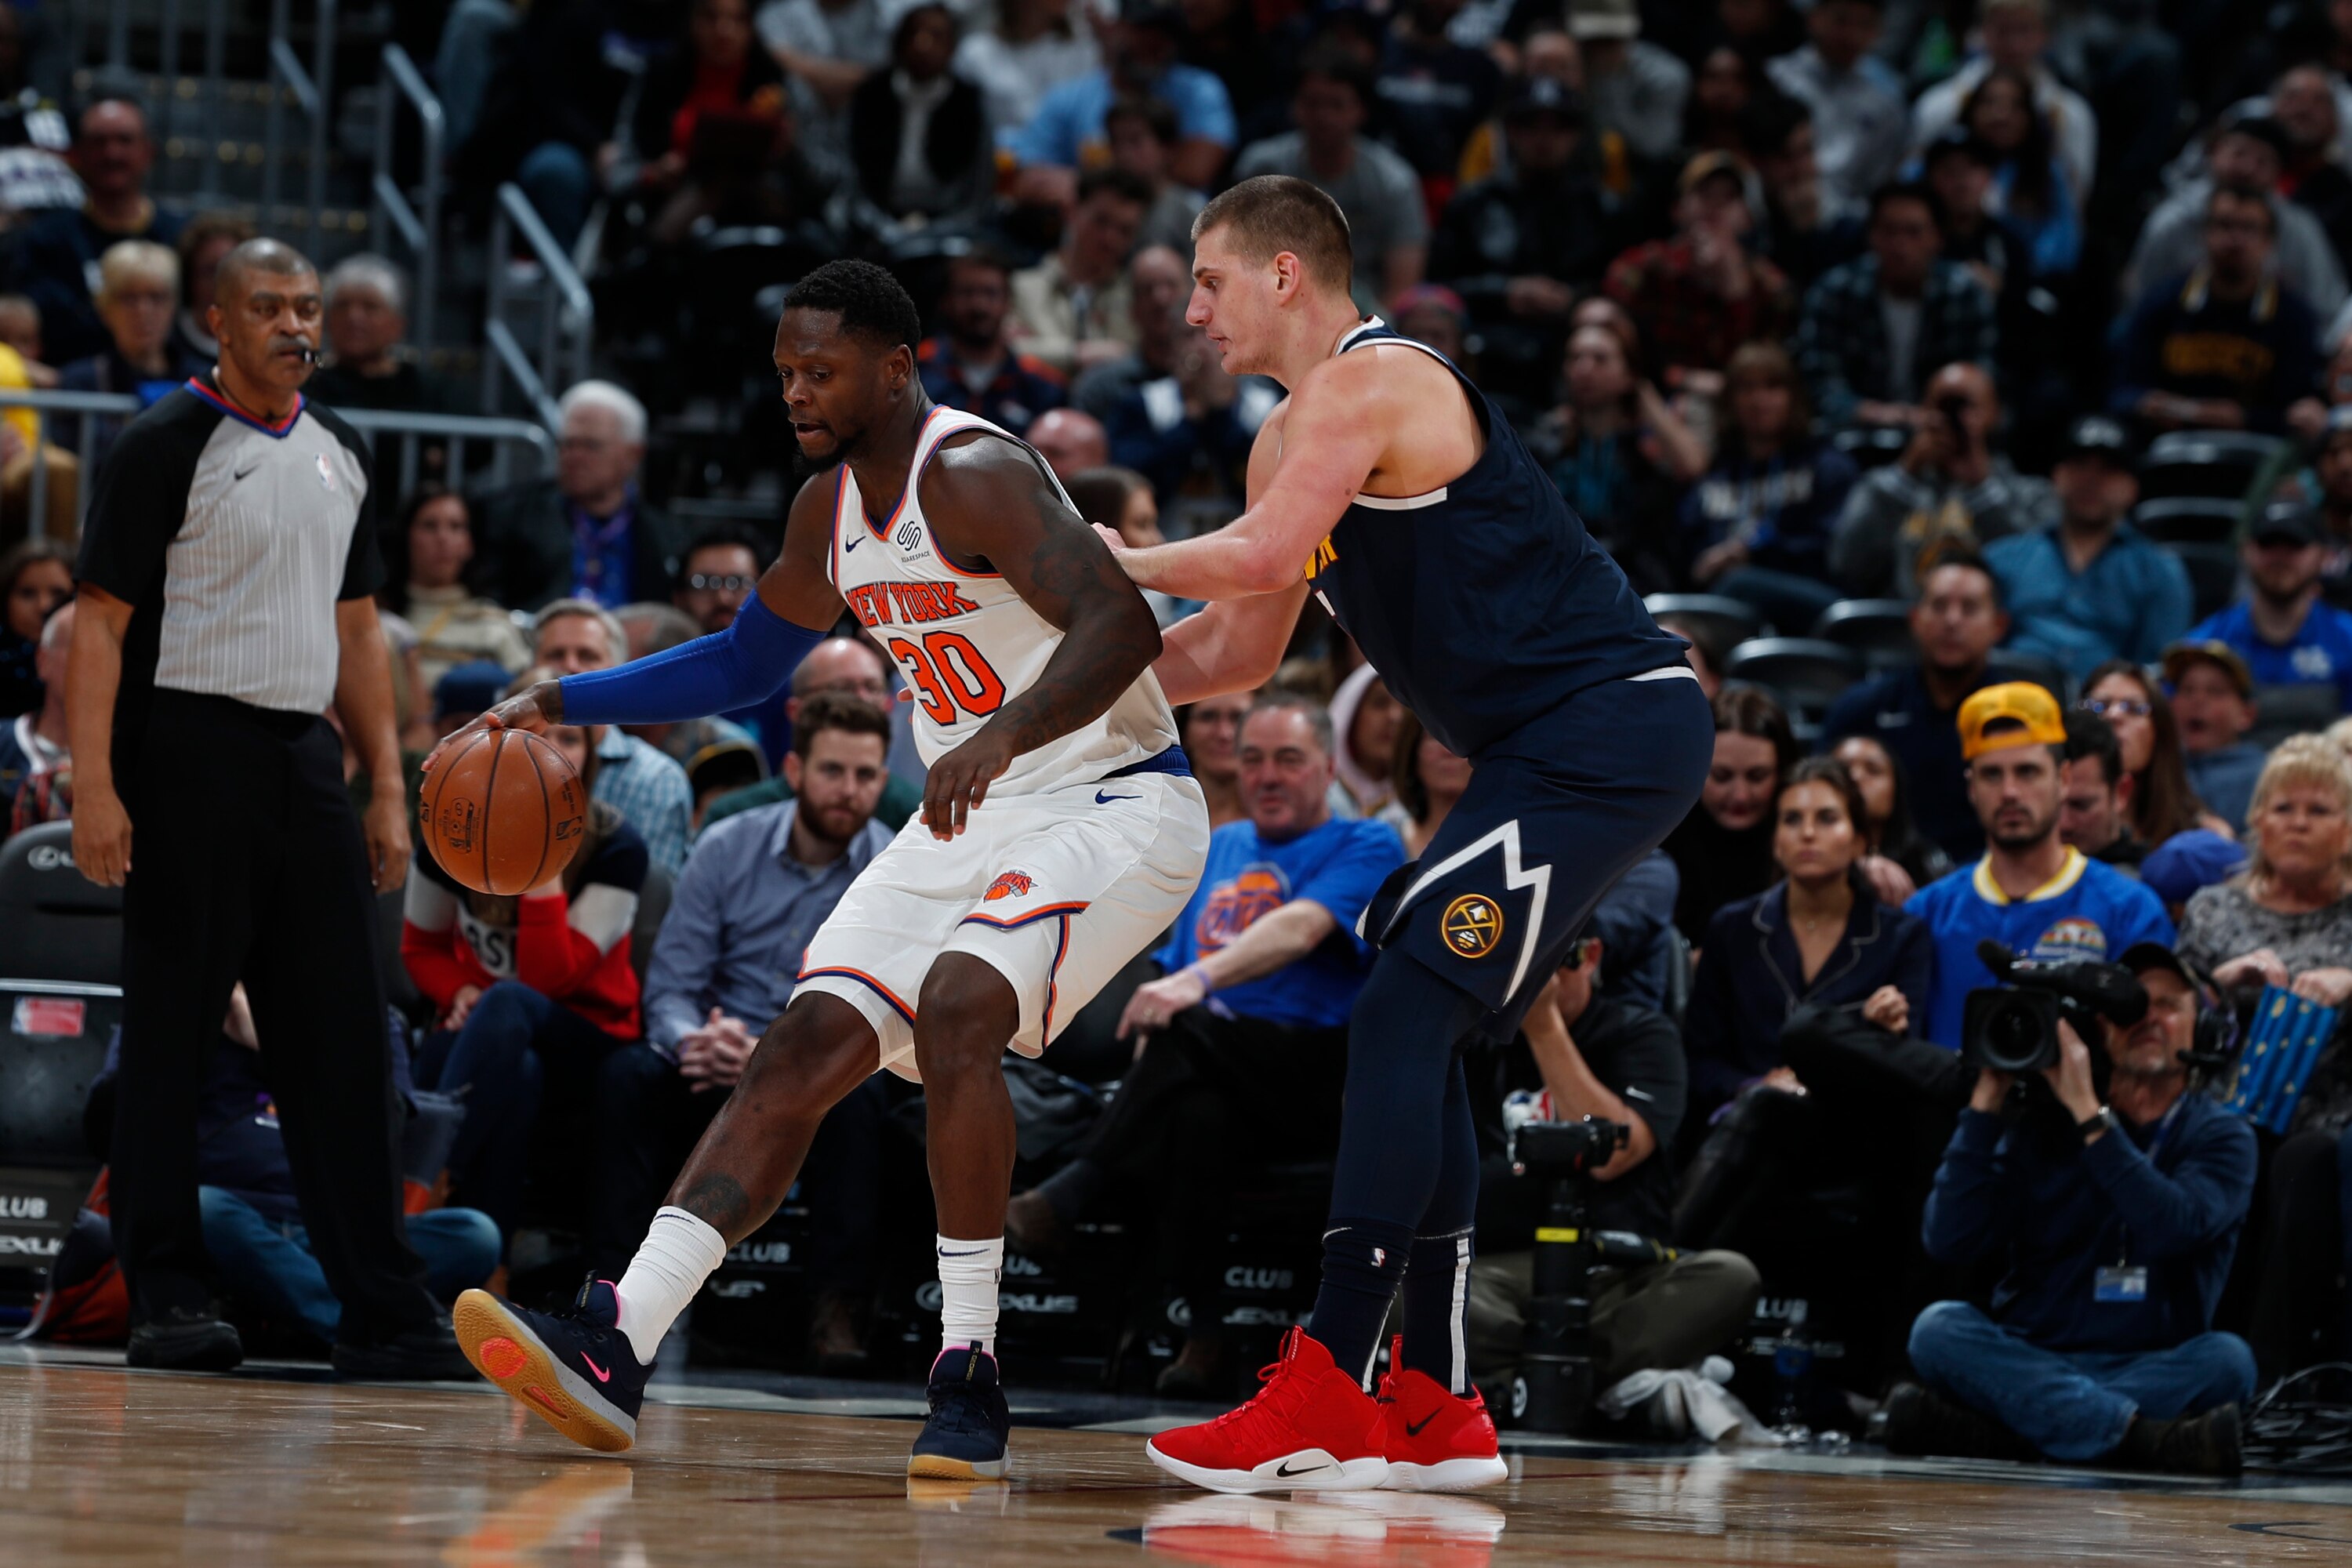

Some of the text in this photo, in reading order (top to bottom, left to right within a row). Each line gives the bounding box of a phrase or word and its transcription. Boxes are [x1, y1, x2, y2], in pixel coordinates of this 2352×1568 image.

[845, 581, 982, 628] NEW YORK
[887, 630, 1007, 727] 30
[0, 1196, 48, 1218] LUB
[998, 1292, 1078, 1312] EXUS
[1755, 1296, 1808, 1325] LUB
